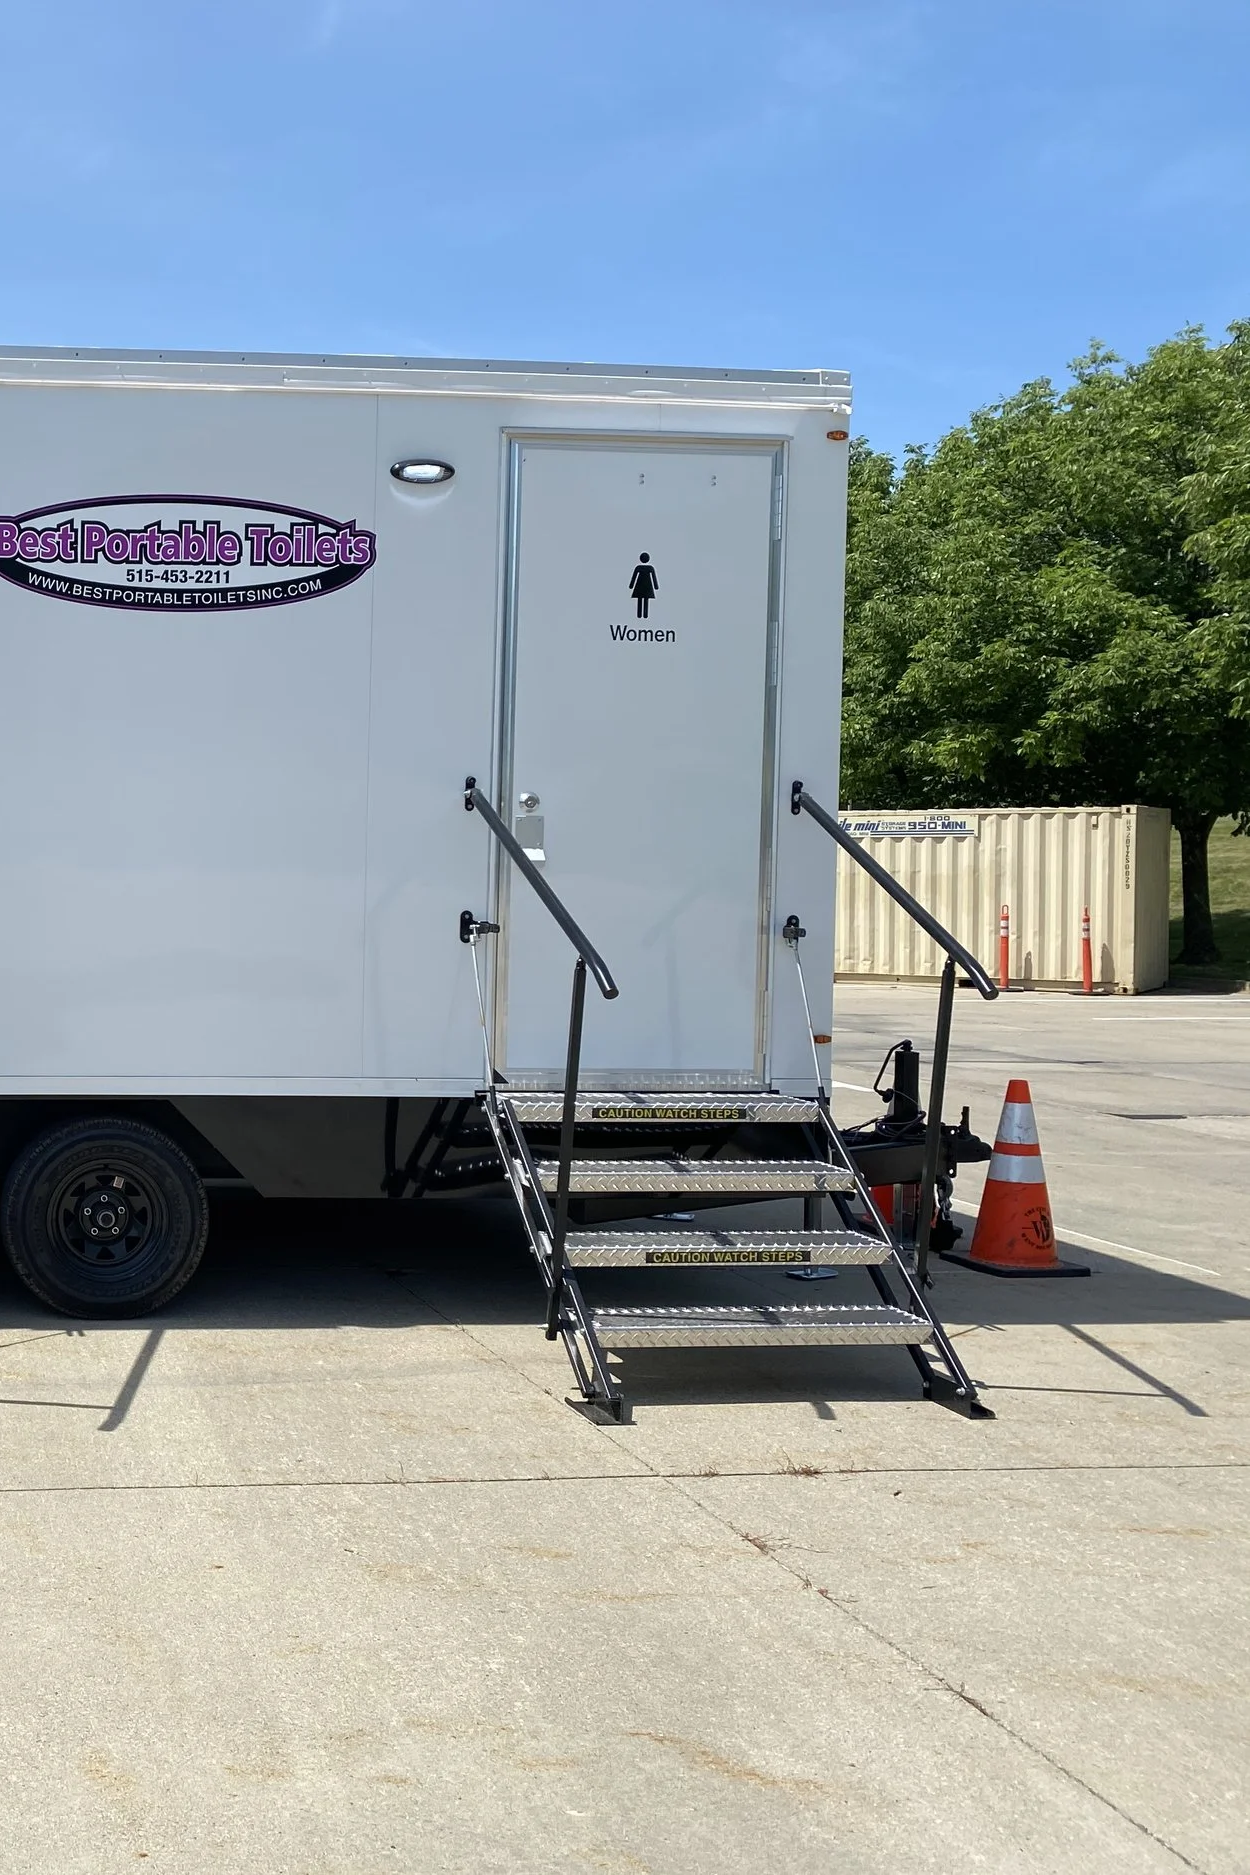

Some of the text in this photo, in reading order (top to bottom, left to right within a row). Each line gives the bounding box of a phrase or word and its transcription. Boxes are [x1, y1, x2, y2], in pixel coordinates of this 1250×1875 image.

[83, 522, 240, 564] Portable
[248, 524, 371, 566] Toilets
[125, 569, 231, 585] 515-453-2211
[27, 571, 323, 606] WWW.BESTPORTABLETOILETSINC.COM
[609, 624, 676, 642] Women
[853, 820, 881, 831] mini
[598, 1108, 739, 1119] CAUTION WATCH STEPS
[653, 1251, 803, 1263] CAUTION WATCH STEPS
